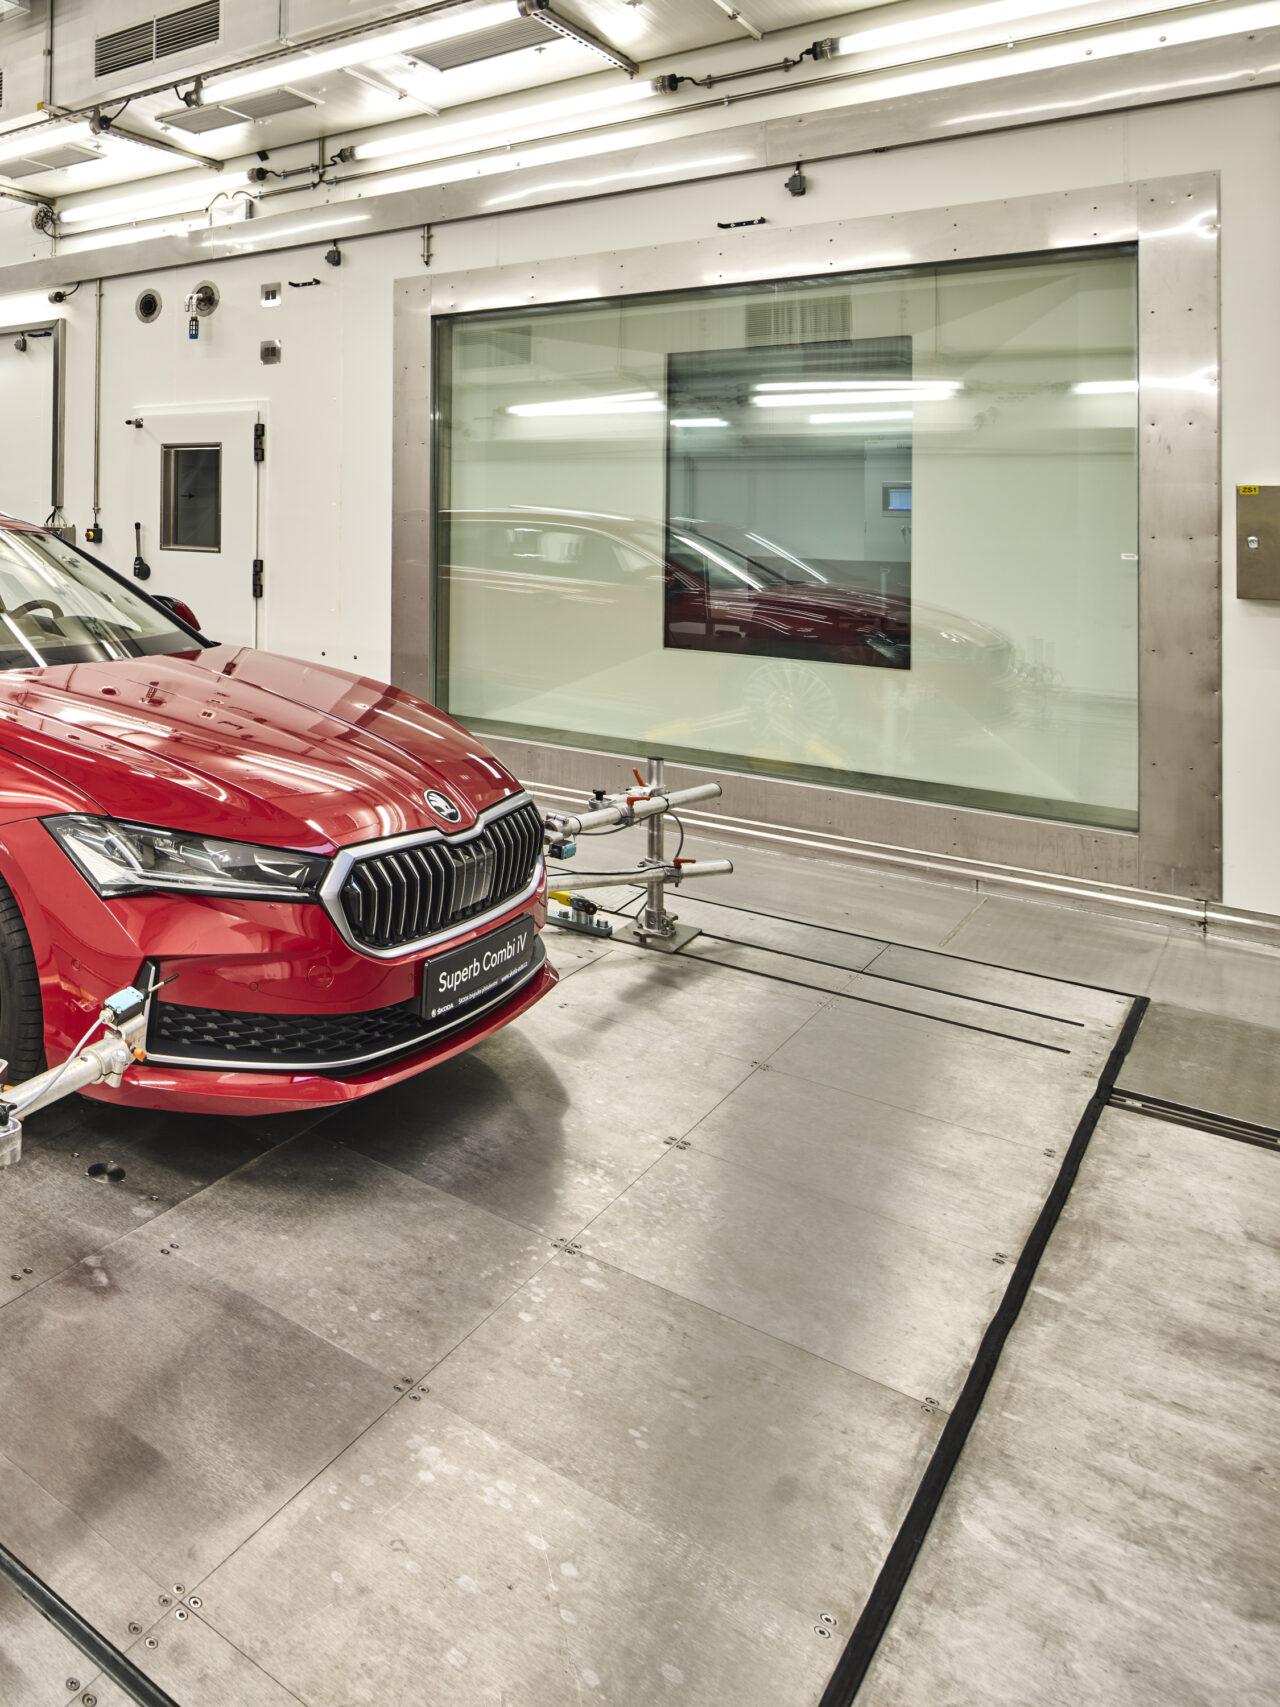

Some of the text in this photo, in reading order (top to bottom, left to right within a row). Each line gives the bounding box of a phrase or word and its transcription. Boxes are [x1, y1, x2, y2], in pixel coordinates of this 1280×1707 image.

[438, 957, 480, 993] Superb
[482, 938, 516, 971] Combi
[516, 932, 528, 953] iV
